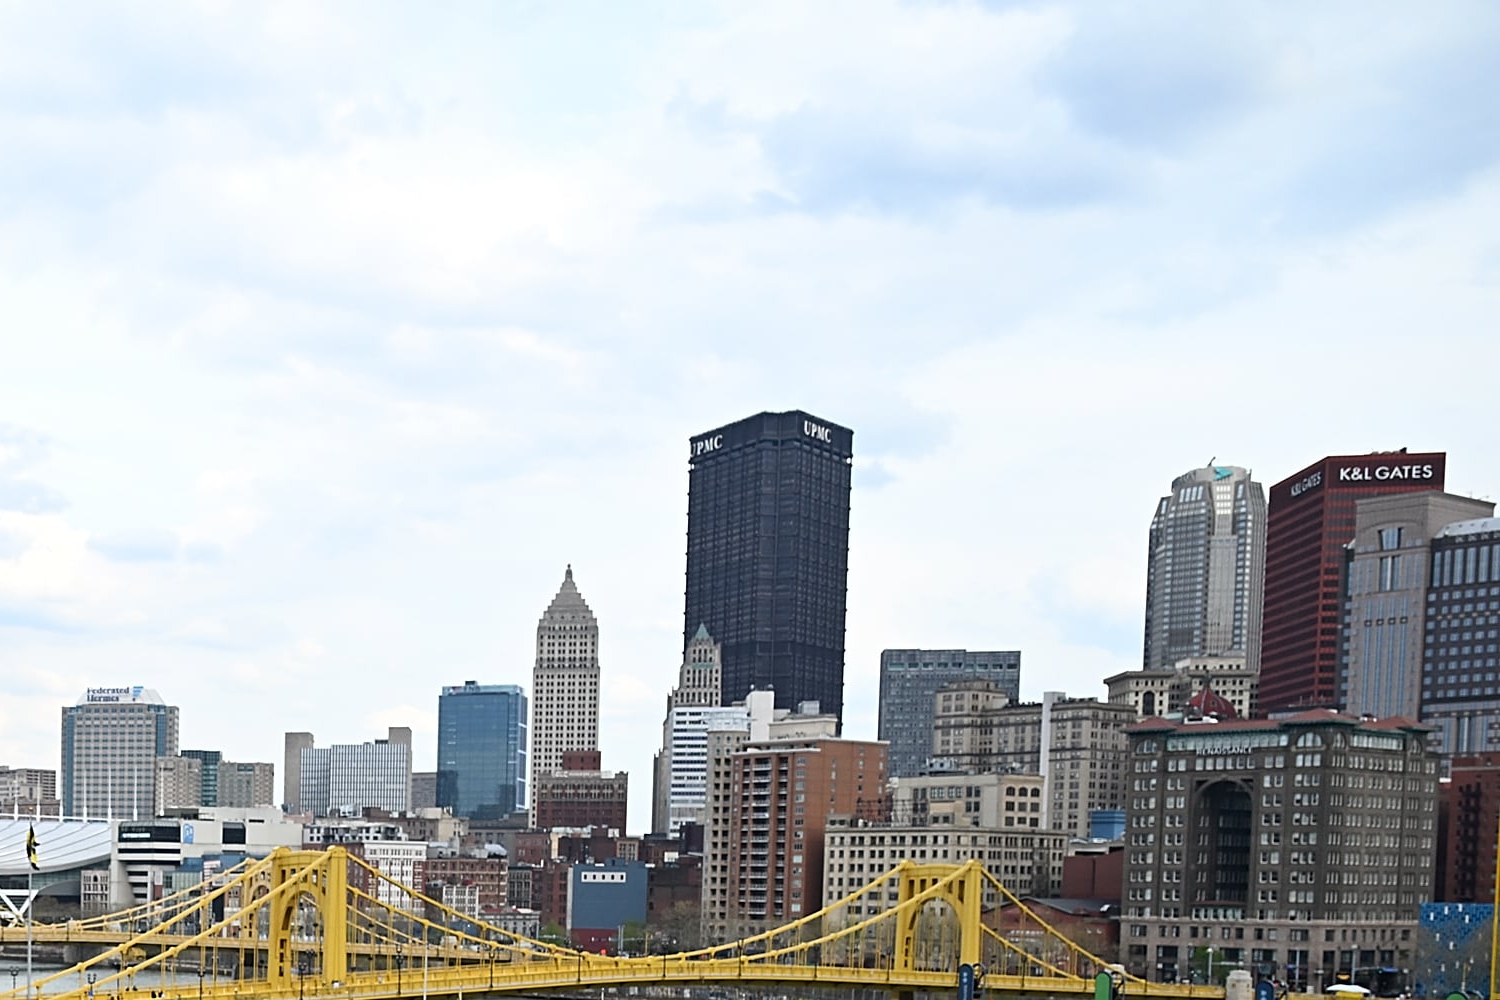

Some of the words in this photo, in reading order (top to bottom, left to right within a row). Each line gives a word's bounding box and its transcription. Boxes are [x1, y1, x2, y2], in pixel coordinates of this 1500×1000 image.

[803, 420, 832, 443] UPMC
[690, 435, 723, 457] UPMC
[1302, 471, 1321, 491] GATES
[1339, 467, 1372, 481] K&L
[1375, 465, 1433, 480] GATES
[87, 687, 130, 695] Federated
